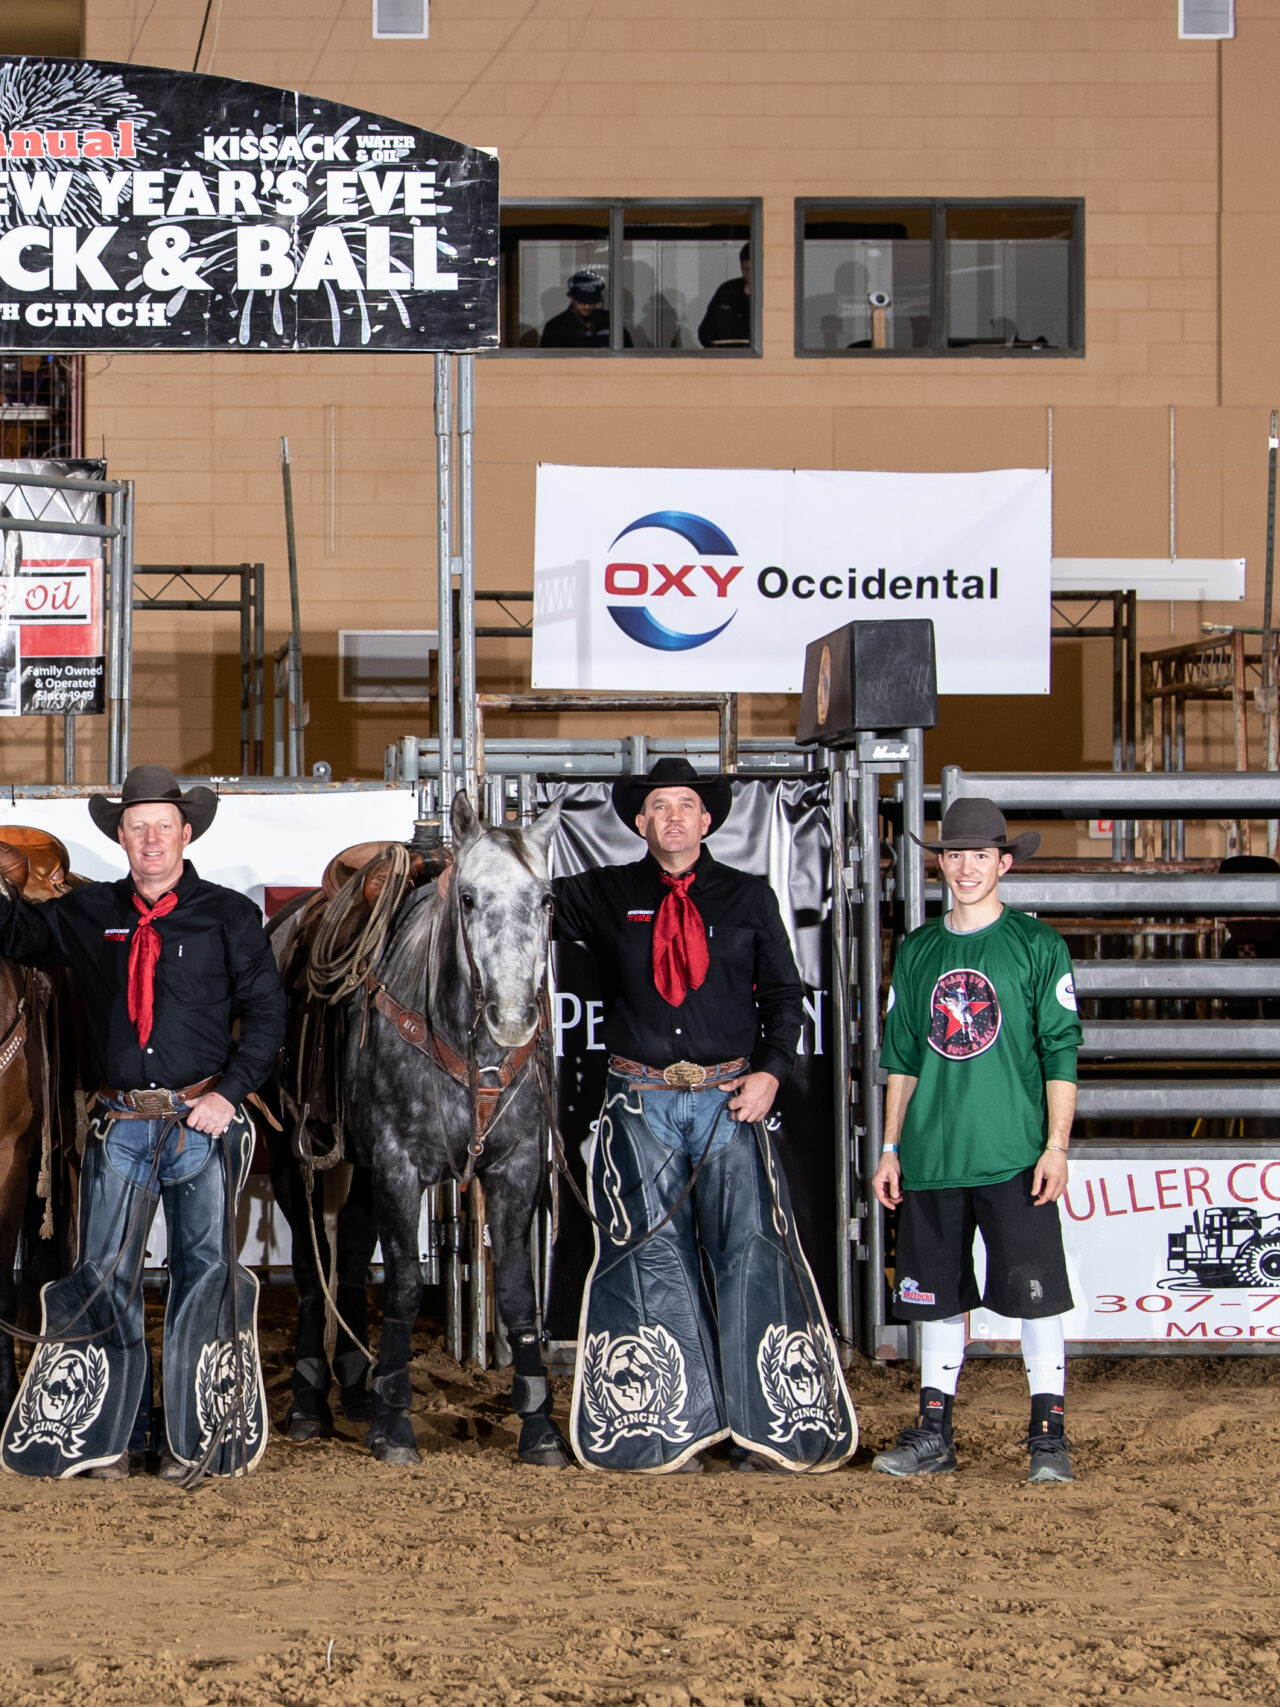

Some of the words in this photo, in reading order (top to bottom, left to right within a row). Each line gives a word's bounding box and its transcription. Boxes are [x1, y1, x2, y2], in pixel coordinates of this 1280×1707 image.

[203, 135, 350, 161] KISSACK
[356, 135, 416, 149] WATER
[356, 149, 369, 163] &
[371, 149, 400, 163] OIL
[94, 169, 310, 217] YEAR'S
[325, 170, 437, 217] EVE
[143, 225, 215, 291] &
[236, 225, 459, 291] BALL
[25, 302, 168, 327] CINCH
[604, 563, 745, 598] OXY
[757, 566, 1000, 600] Occidental
[24, 580, 81, 611] Oil
[27, 665, 63, 678] Family
[64, 664, 103, 676] Owned
[34, 678, 44, 688] &
[45, 677, 97, 692] Operated
[403, 1019, 419, 1035] BC
[614, 1413, 660, 1428] CINCH
[792, 1408, 825, 1420] CINCH
[33, 1423, 65, 1435] CINCH
